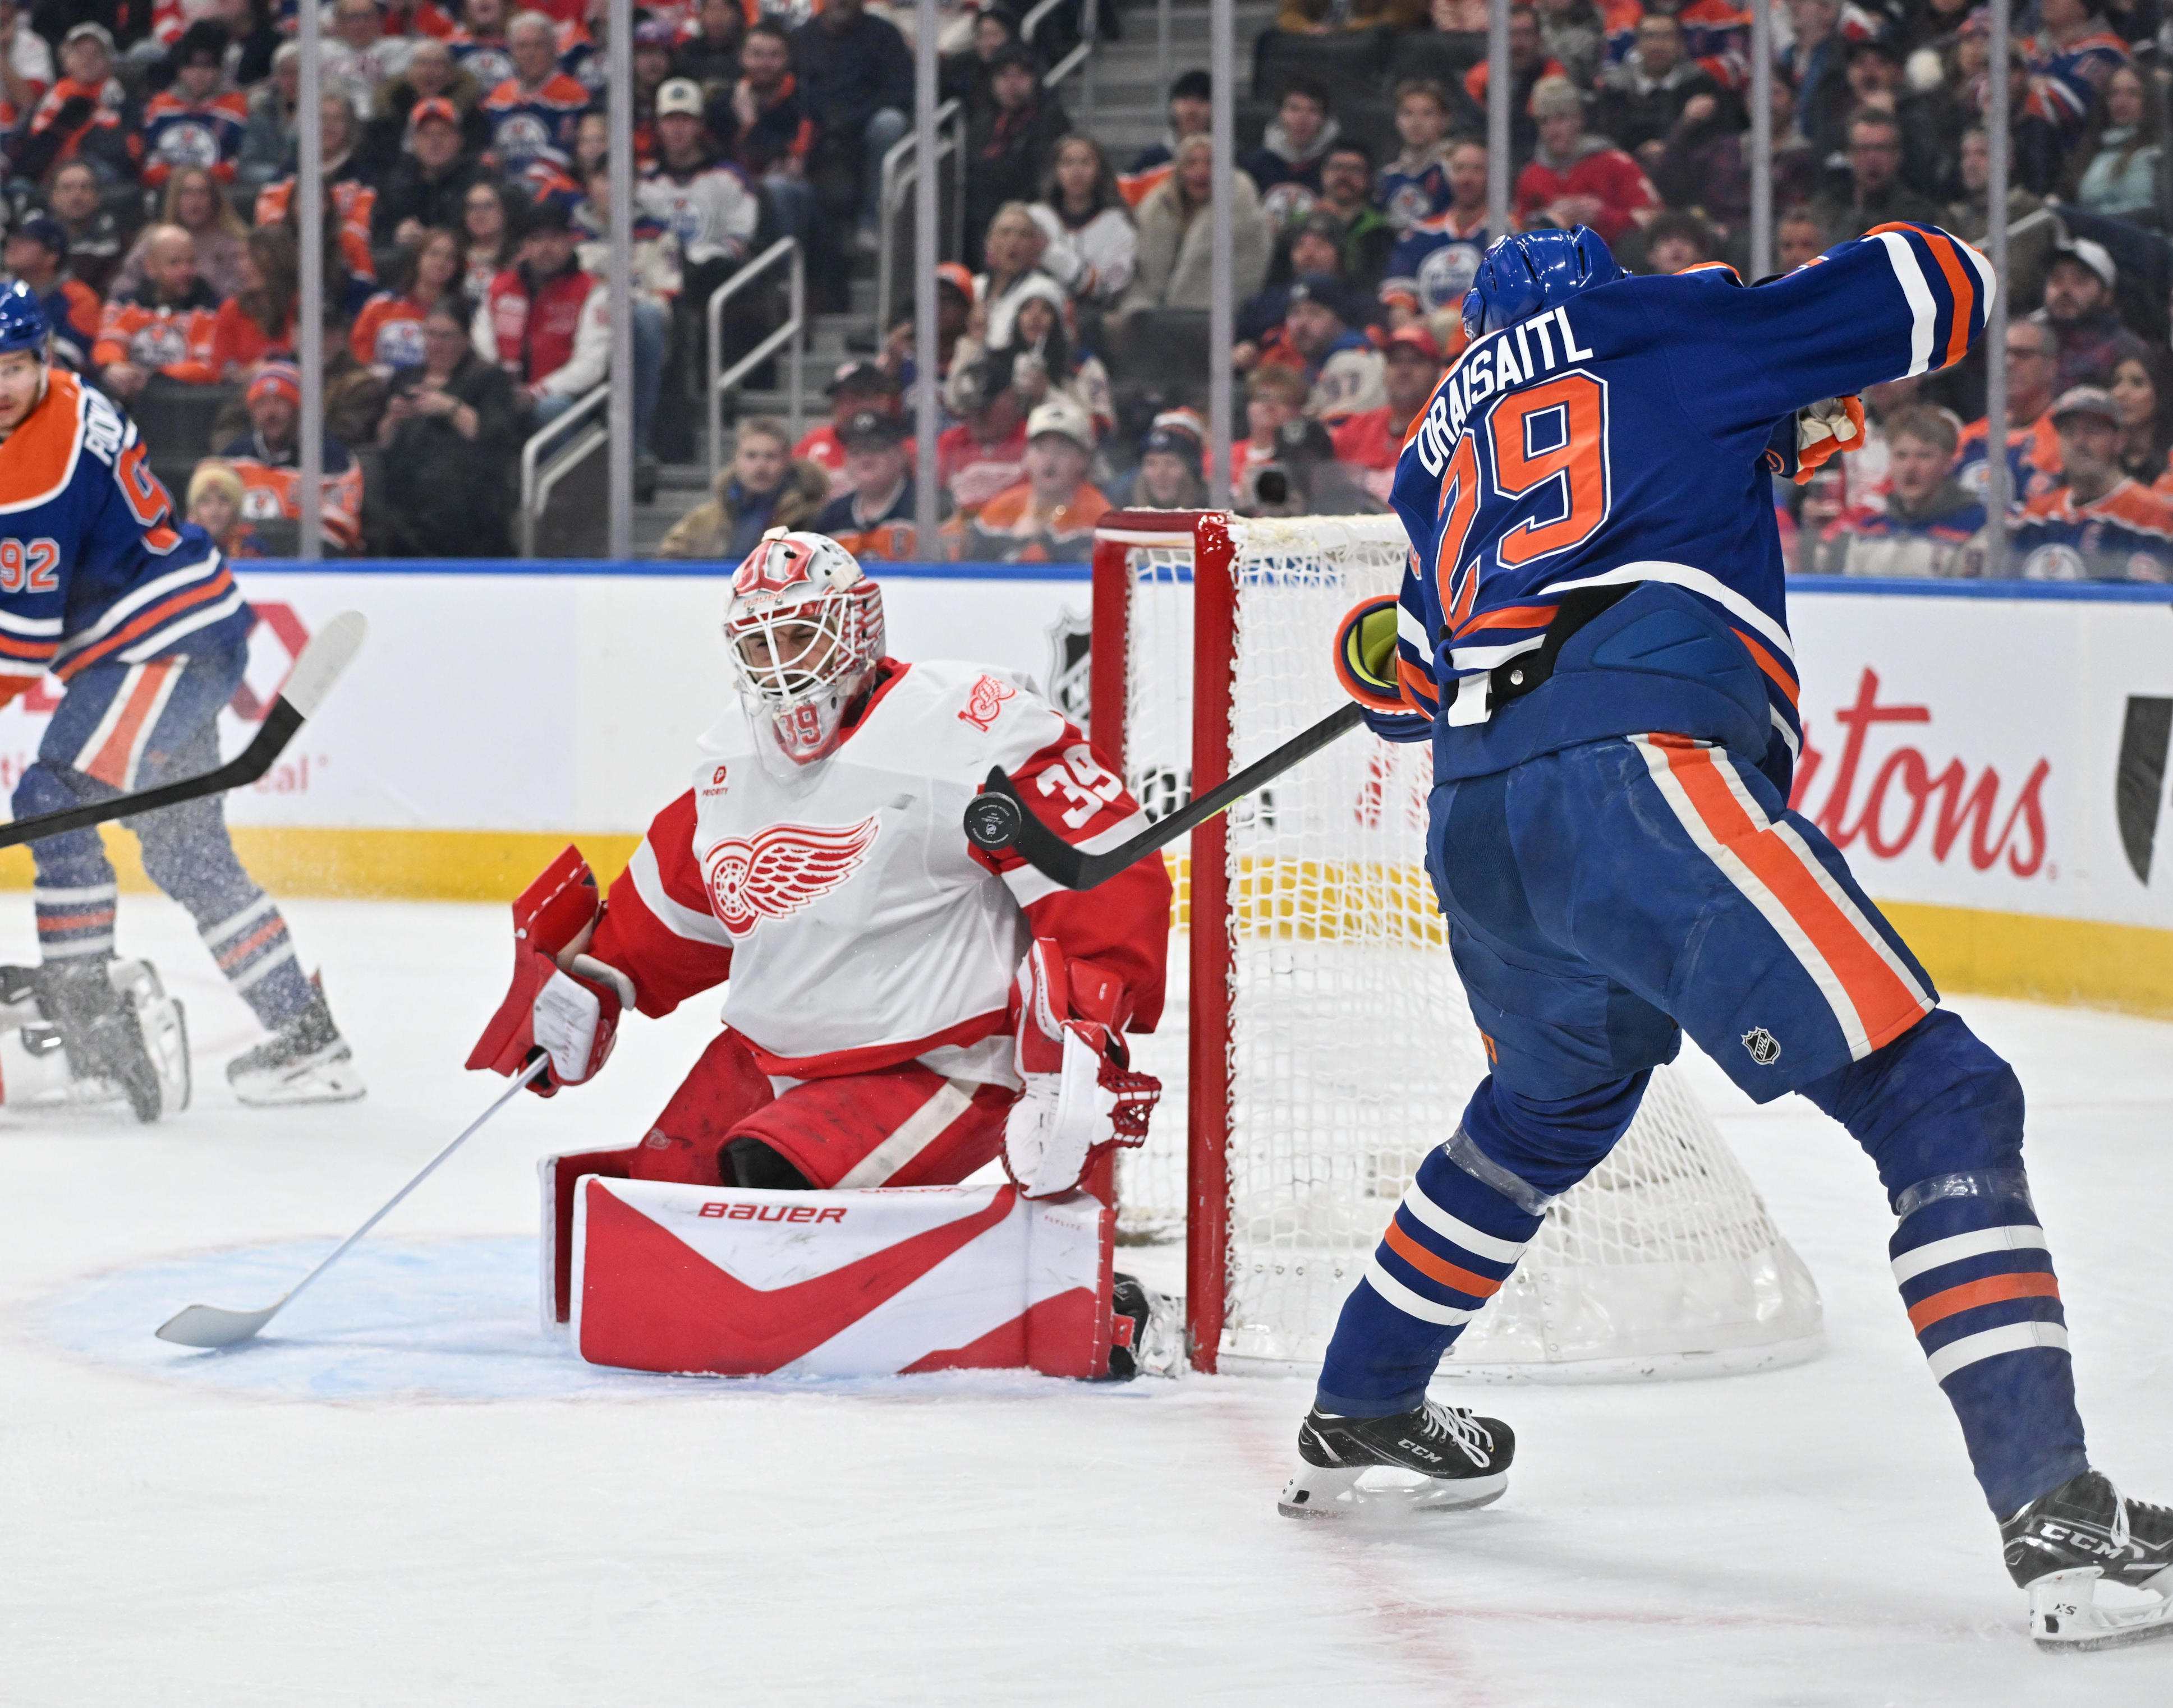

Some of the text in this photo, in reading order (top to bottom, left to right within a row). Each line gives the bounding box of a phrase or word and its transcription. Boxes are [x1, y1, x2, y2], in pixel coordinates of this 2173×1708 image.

[1418, 306, 1593, 477] DRAISAITL
[1436, 369, 1610, 634] 29
[0, 537, 60, 593] 92
[1036, 743, 1124, 830] 39
[1756, 1036, 1768, 1059] NHL
[1398, 1438, 1443, 1463] CCM
[2039, 1522, 2125, 1559] CCM
